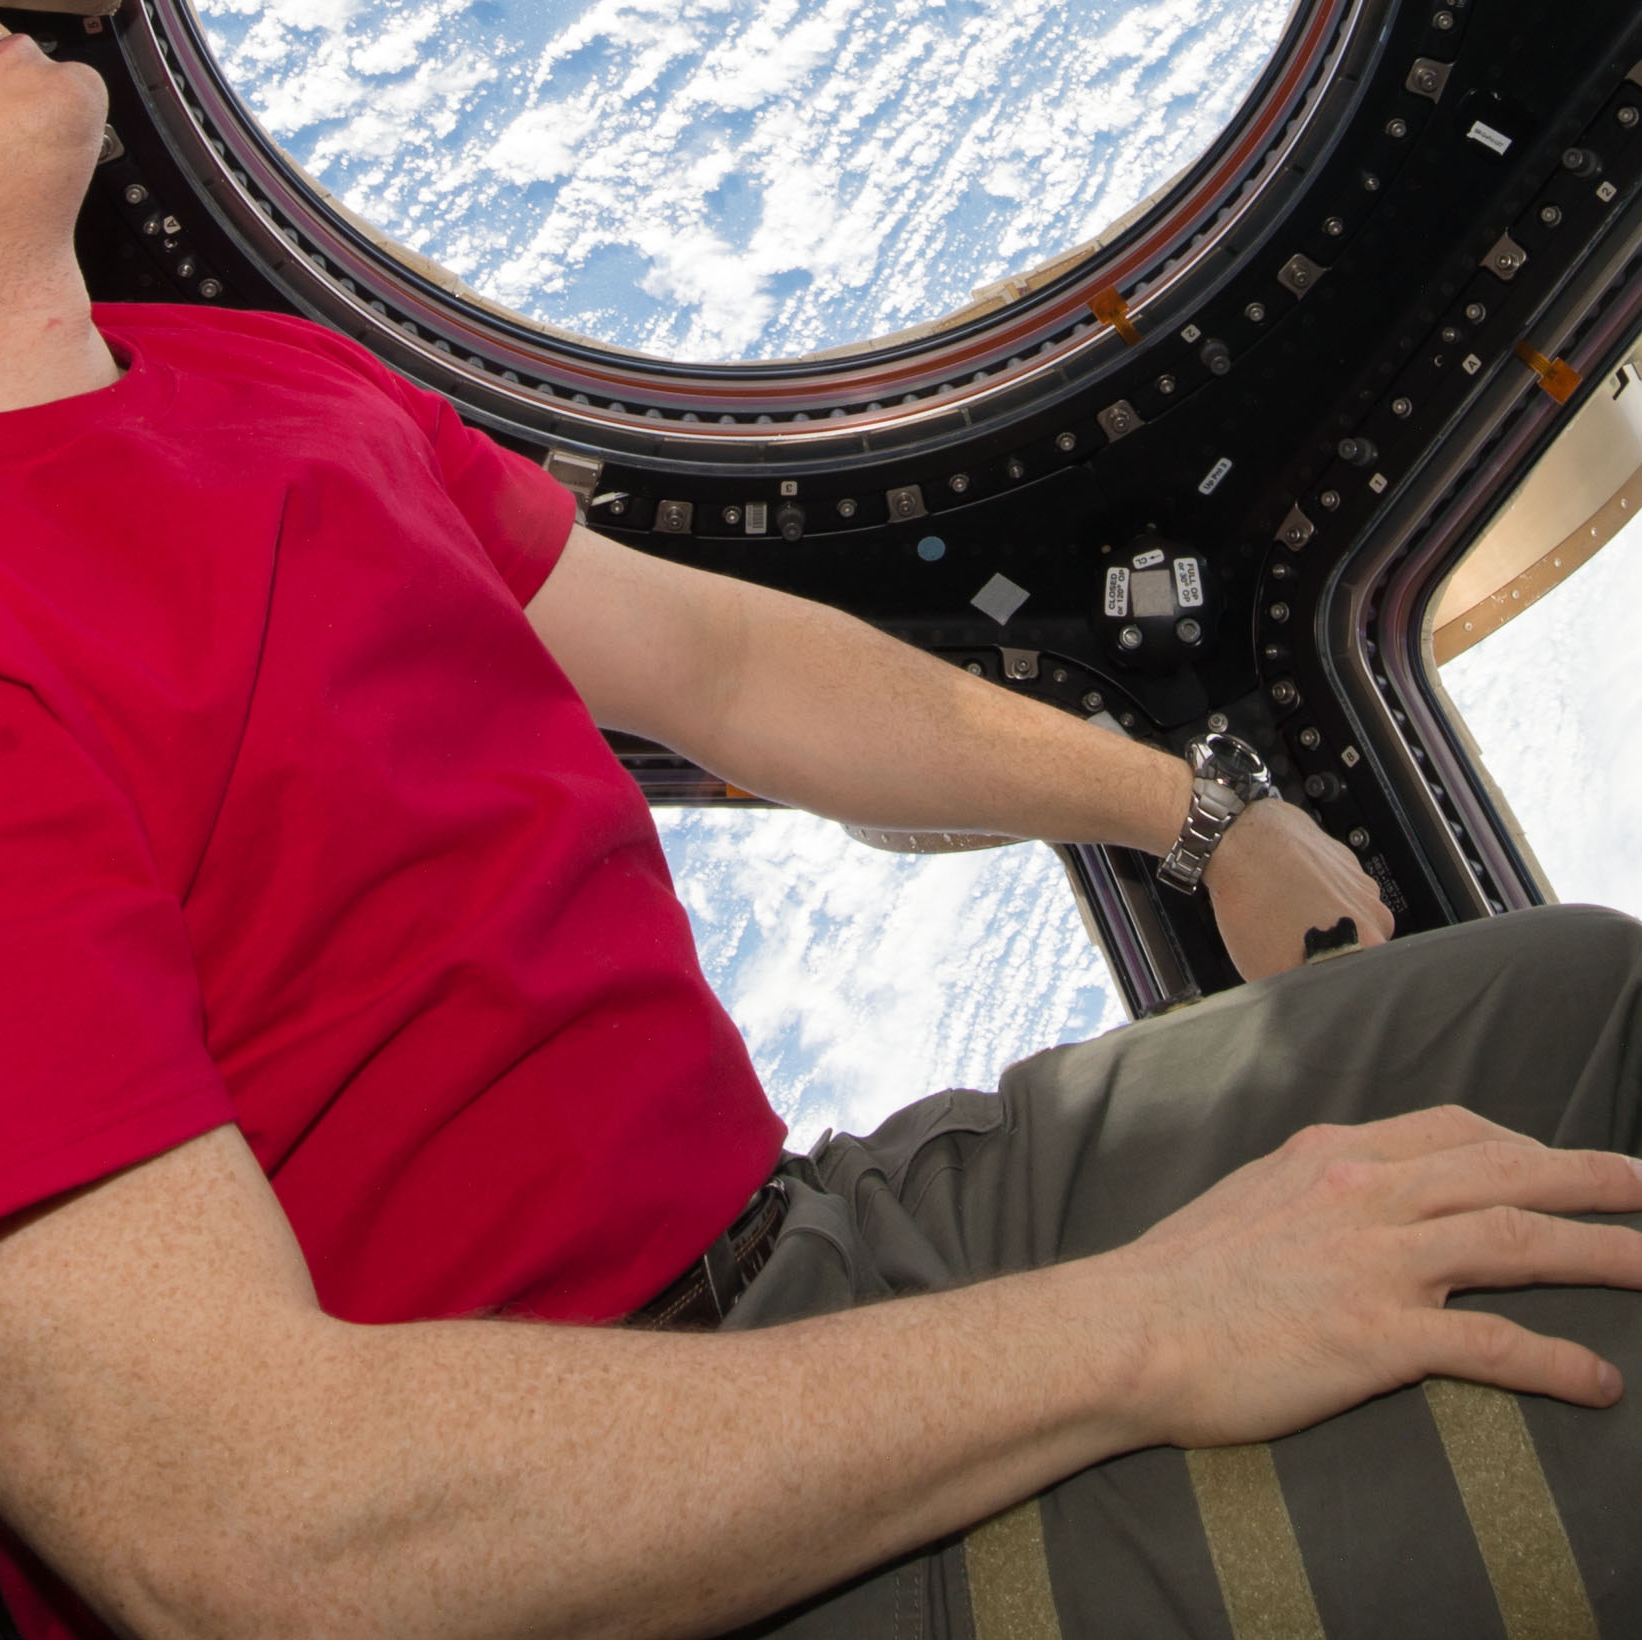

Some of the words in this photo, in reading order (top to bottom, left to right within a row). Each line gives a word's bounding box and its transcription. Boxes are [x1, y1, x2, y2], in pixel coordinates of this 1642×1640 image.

[1600, 185, 1613, 197] 2
[166, 218, 177, 229] A
[1185, 326, 1197, 339] 2
[1466, 358, 1478, 370] A
[1202, 478, 1215, 491] Up
[1211, 468, 1223, 480] Pnl
[785, 482, 793, 493] 3
[1134, 555, 1147, 565] CL
[1176, 561, 1185, 572] or
[1117, 568, 1126, 582] OP
[1184, 563, 1196, 584] FULL
[1108, 572, 1118, 609] CLOSED
[1180, 588, 1190, 603] OP
[1188, 586, 1198, 601] OP
[1116, 605, 1124, 614] or
[1344, 750, 1356, 762] 8
